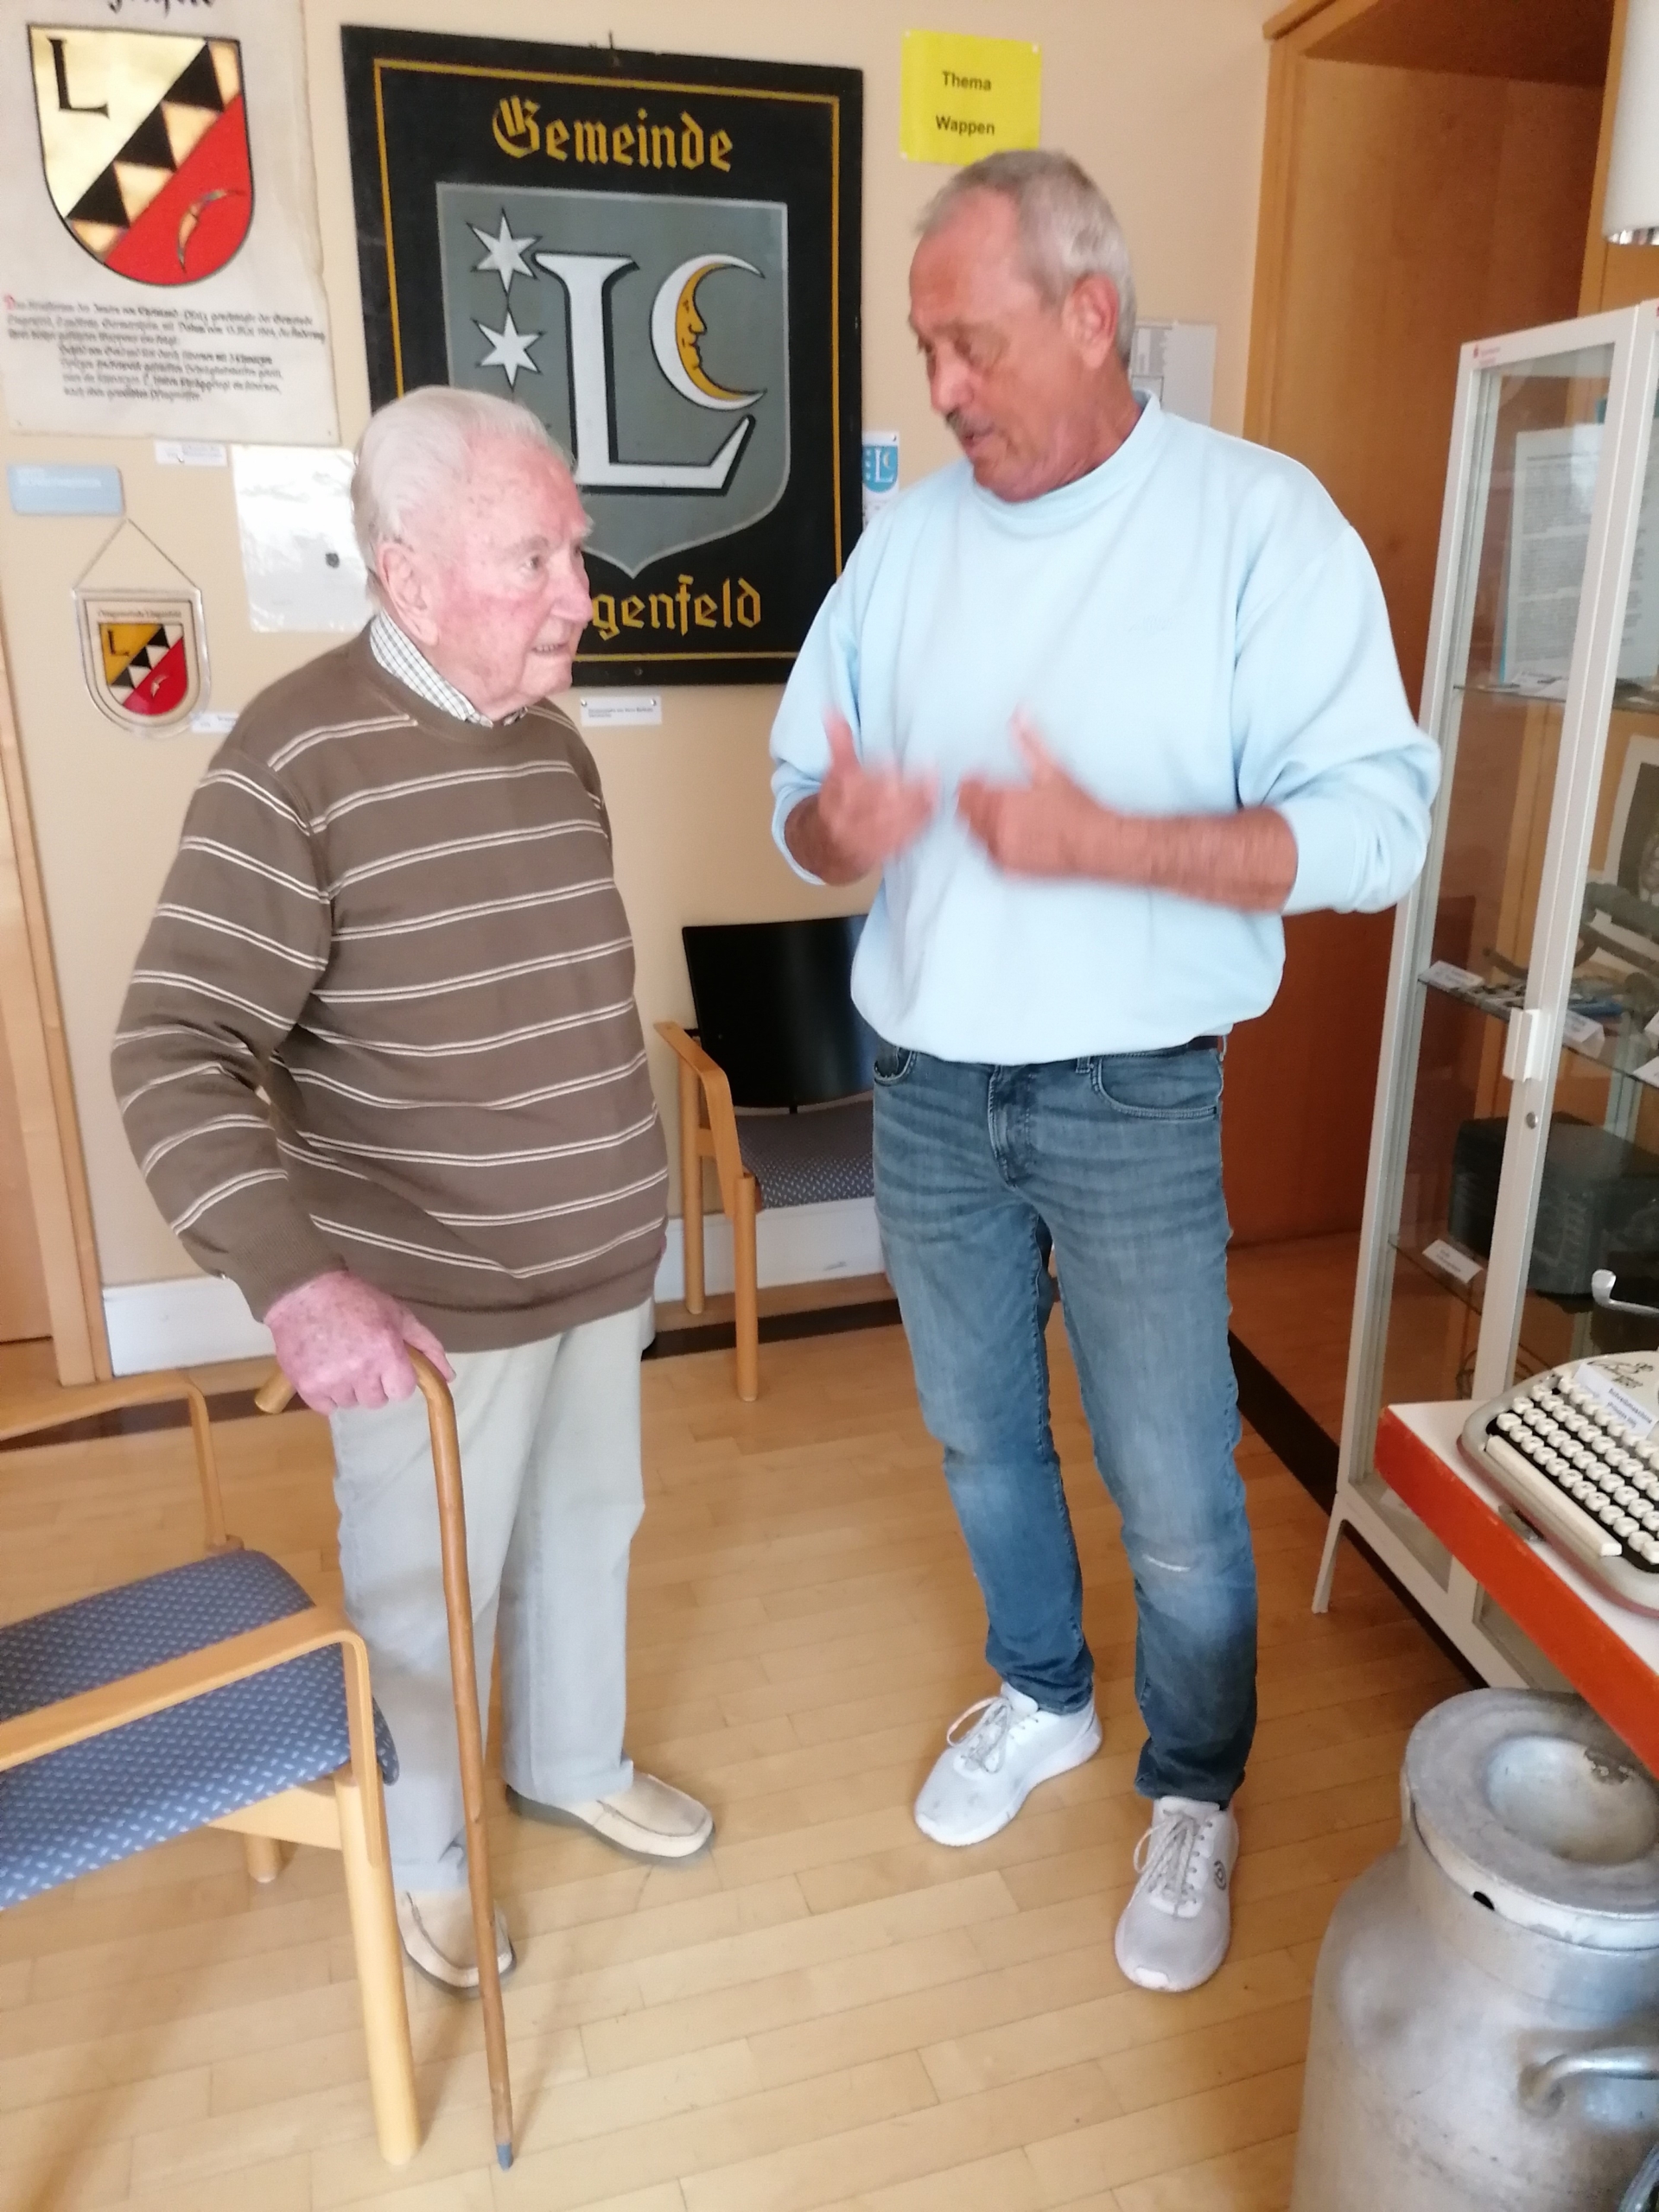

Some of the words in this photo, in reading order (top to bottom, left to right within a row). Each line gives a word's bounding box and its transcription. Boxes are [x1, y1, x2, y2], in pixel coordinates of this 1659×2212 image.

[48, 37, 111, 119] L
[941, 70, 992, 92] Thema
[492, 95, 734, 173] Gemeinde
[935, 114, 995, 137] Wappen
[534, 251, 755, 495] L
[591, 573, 762, 642] genfeld
